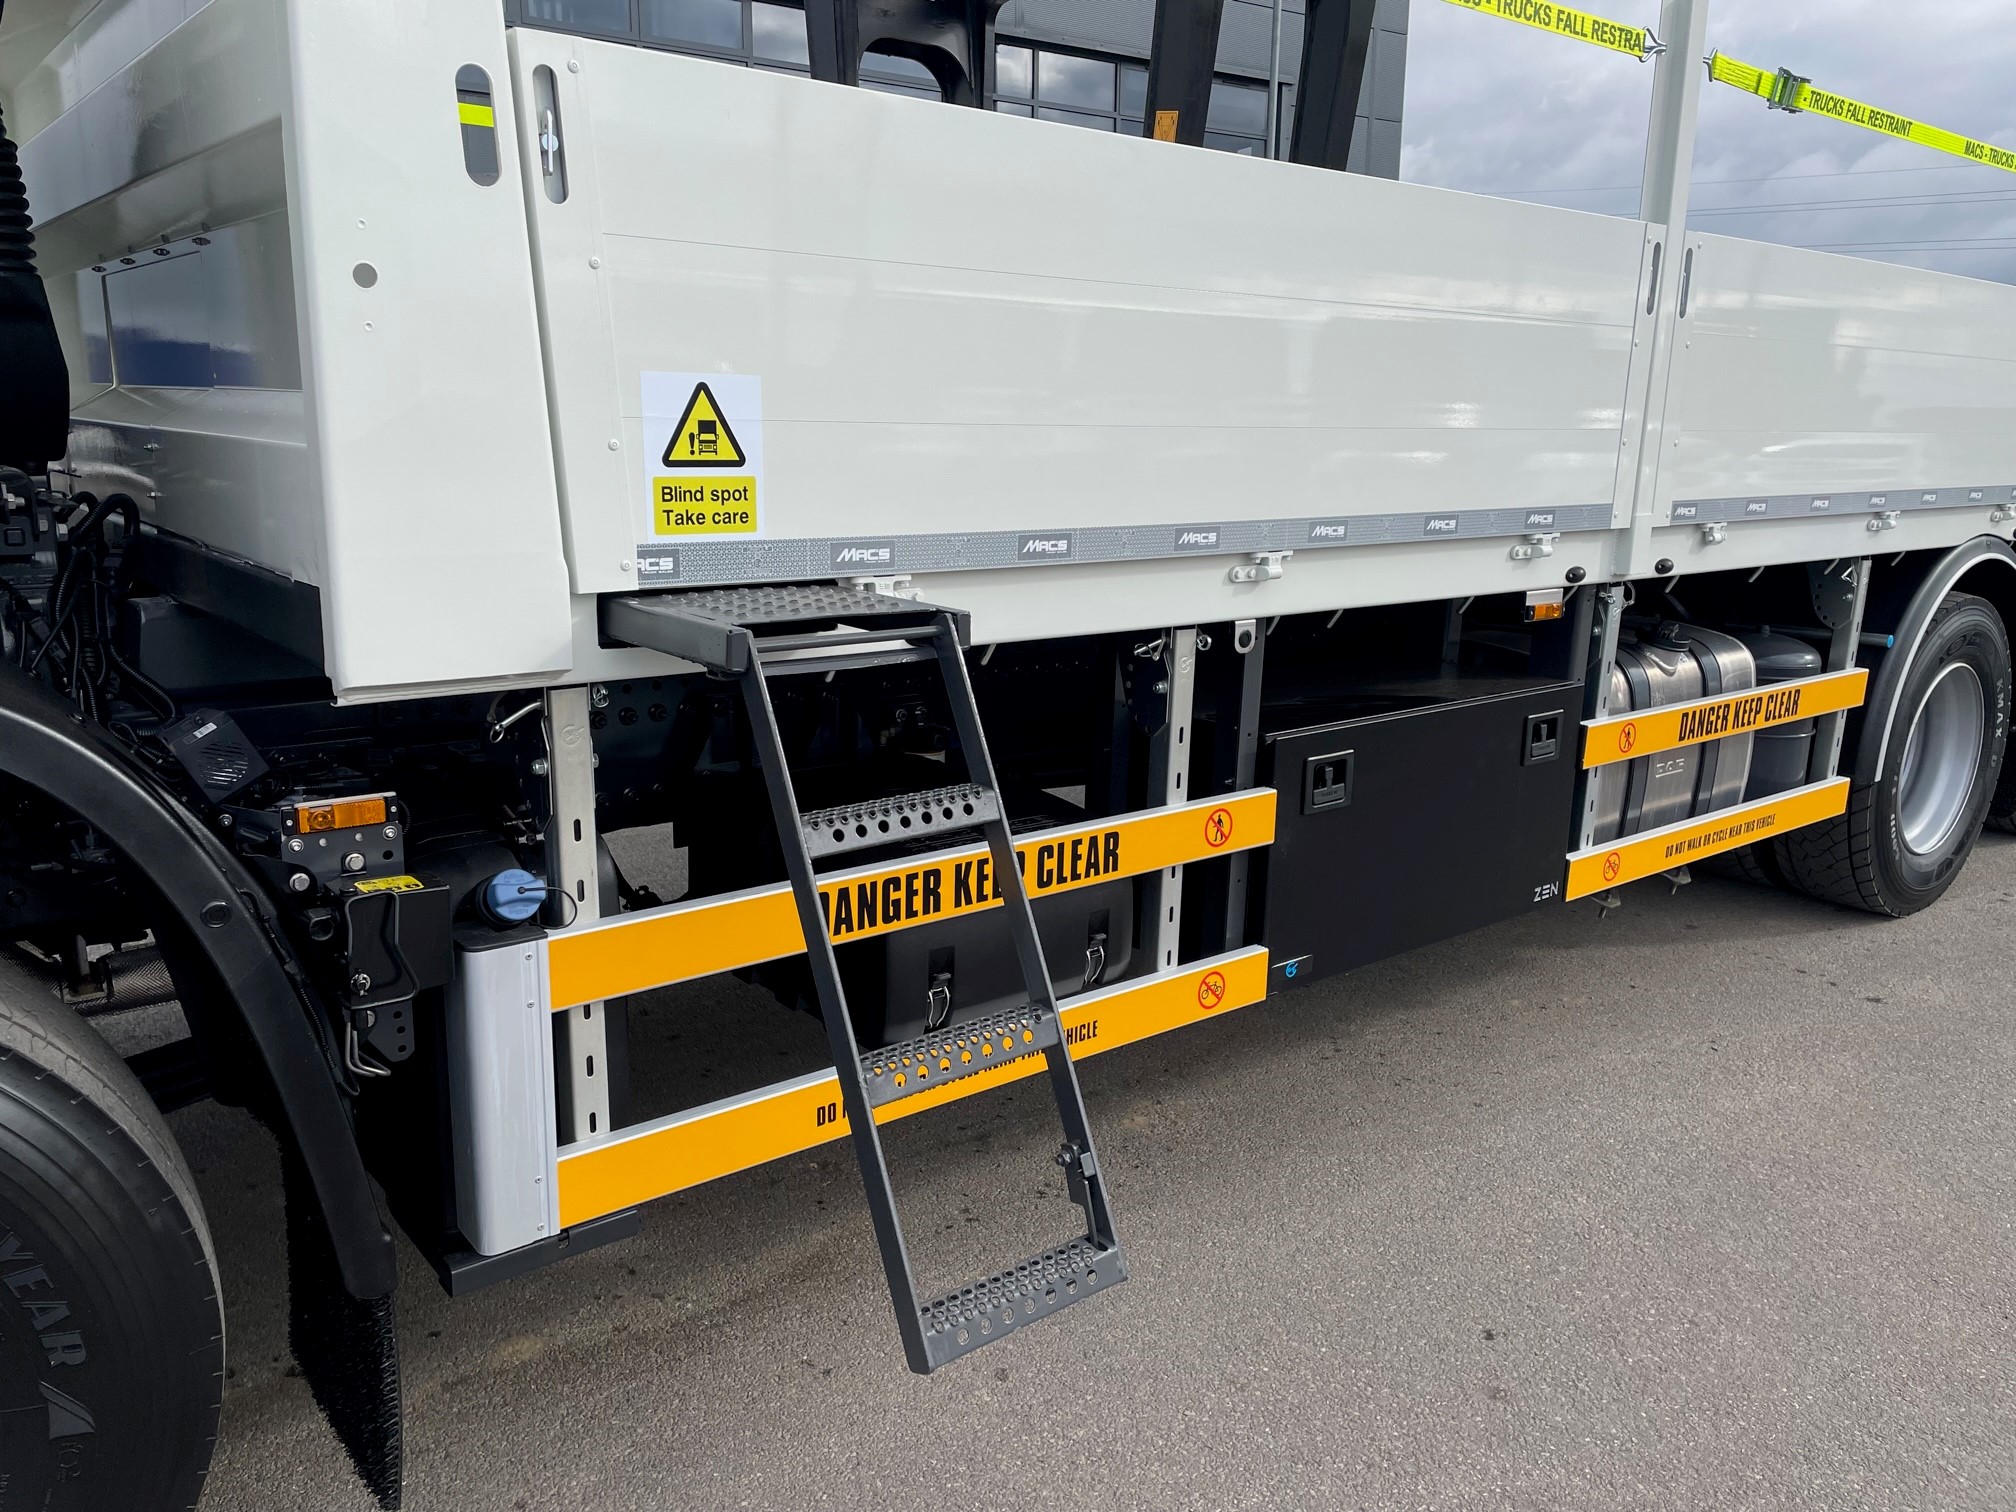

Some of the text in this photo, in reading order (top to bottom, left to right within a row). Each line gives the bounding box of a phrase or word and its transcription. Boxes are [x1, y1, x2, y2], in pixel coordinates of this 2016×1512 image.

[1496, 0, 1551, 26] TRUCKS
[1556, 9, 1587, 38] FALL
[1808, 90, 1846, 116] TRUCKS
[1846, 102, 1865, 123] FALL
[1868, 111, 1913, 137] RESTRAINT
[1964, 140, 1984, 159] MACS
[1988, 147, 2015, 168] TRUCKS
[661, 486, 749, 505] Blind spot
[662, 509, 749, 526] Take care
[1678, 688, 1801, 742] DANGER KEEP CLEAR
[1675, 840, 1686, 855] NOT
[1687, 835, 1702, 851] WALK
[1703, 833, 1711, 847] OR
[1711, 828, 1728, 844] CYCLE
[1728, 823, 1742, 838] NEAR
[1743, 820, 1756, 835] THIS
[1756, 813, 1776, 830] VEHICLE
[1036, 831, 1120, 889] CLEAR
[1533, 881, 1559, 902] ZEN
[817, 1102, 836, 1127] DO
